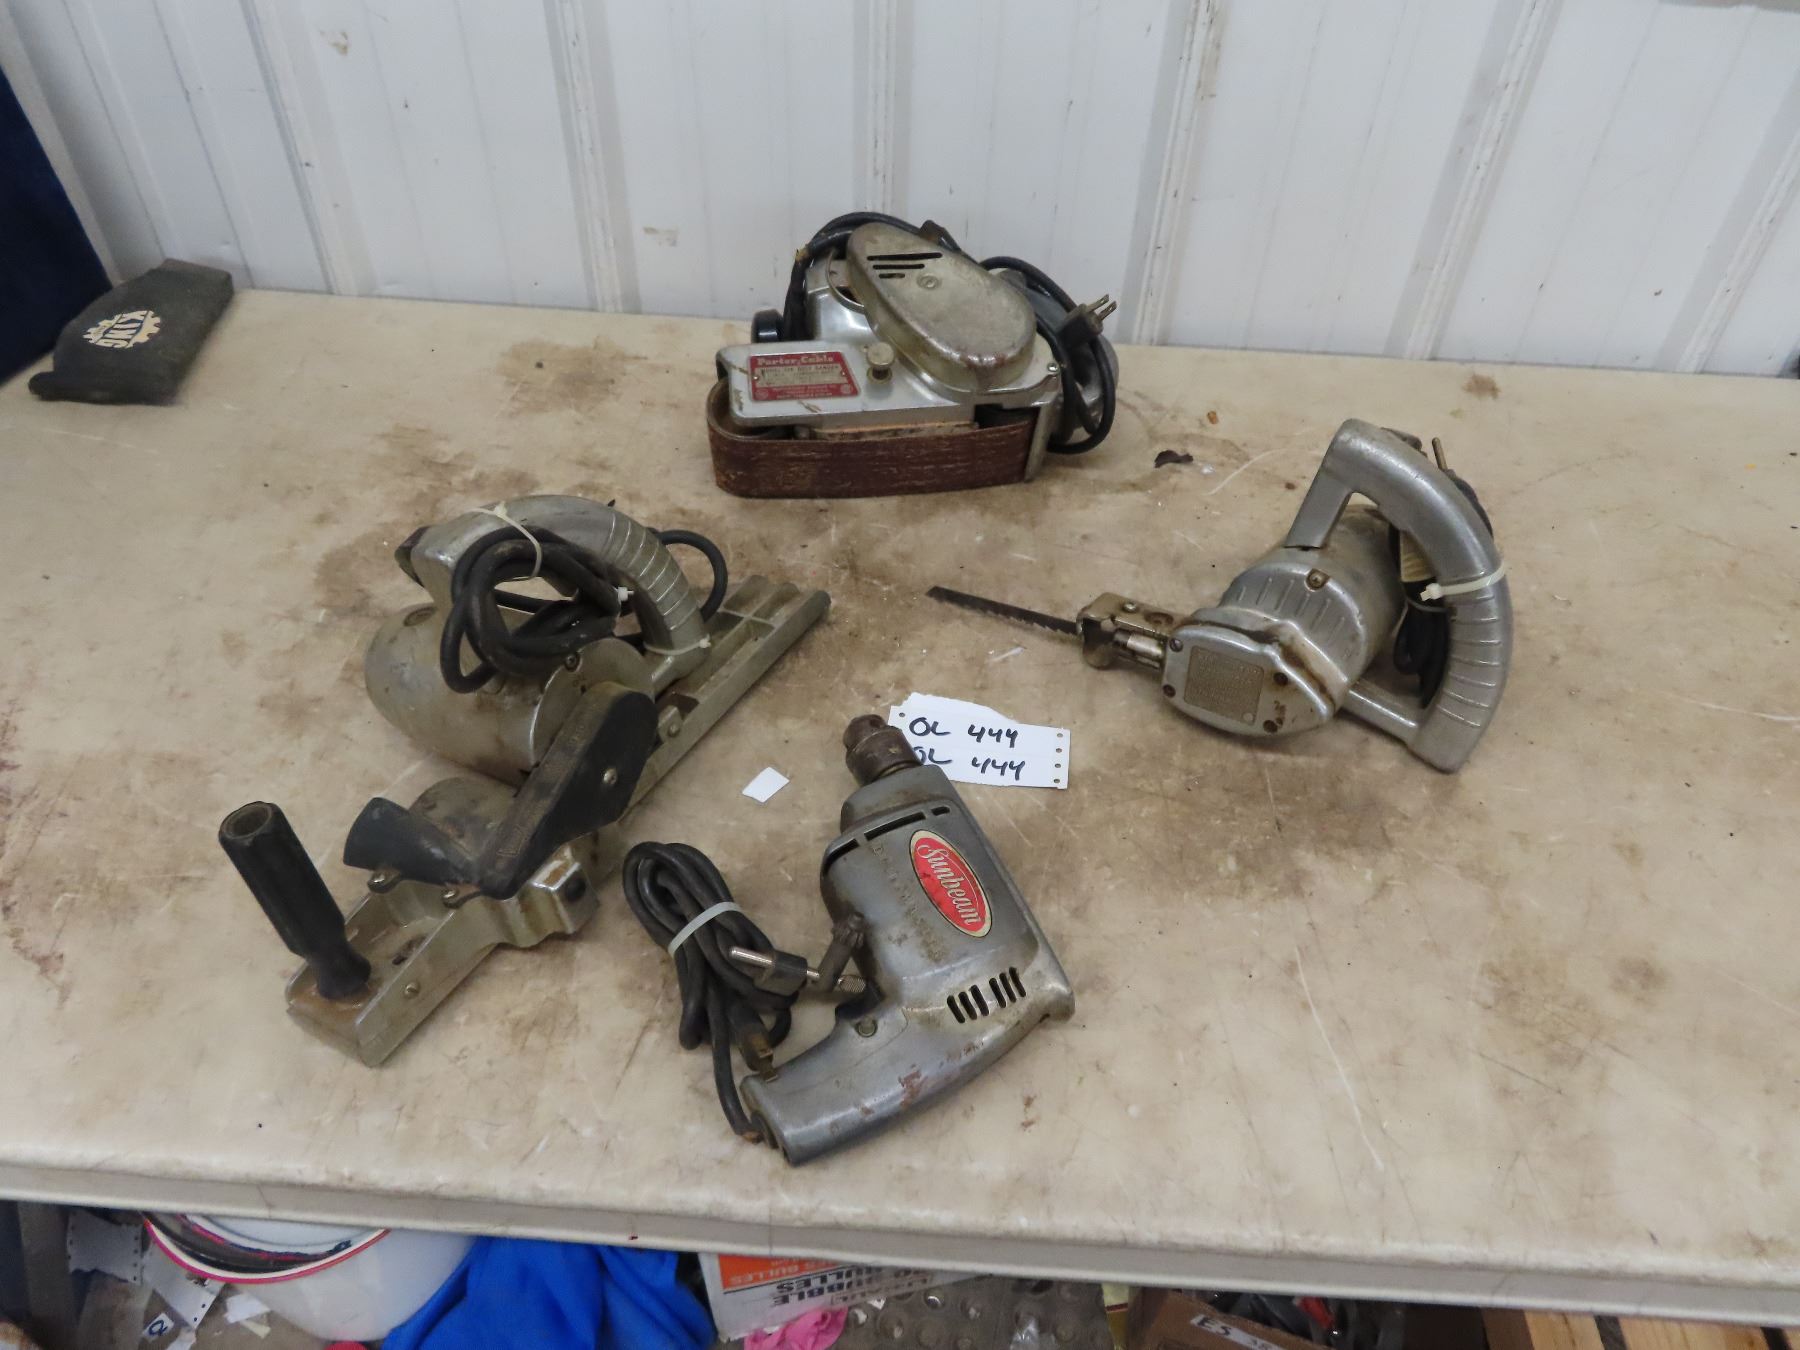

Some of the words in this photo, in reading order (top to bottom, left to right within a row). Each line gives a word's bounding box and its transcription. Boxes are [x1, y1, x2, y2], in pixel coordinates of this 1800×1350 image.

[967, 723, 1019, 748] 444
[971, 756, 1026, 781] 444
[916, 844, 981, 926] Sunbeam
